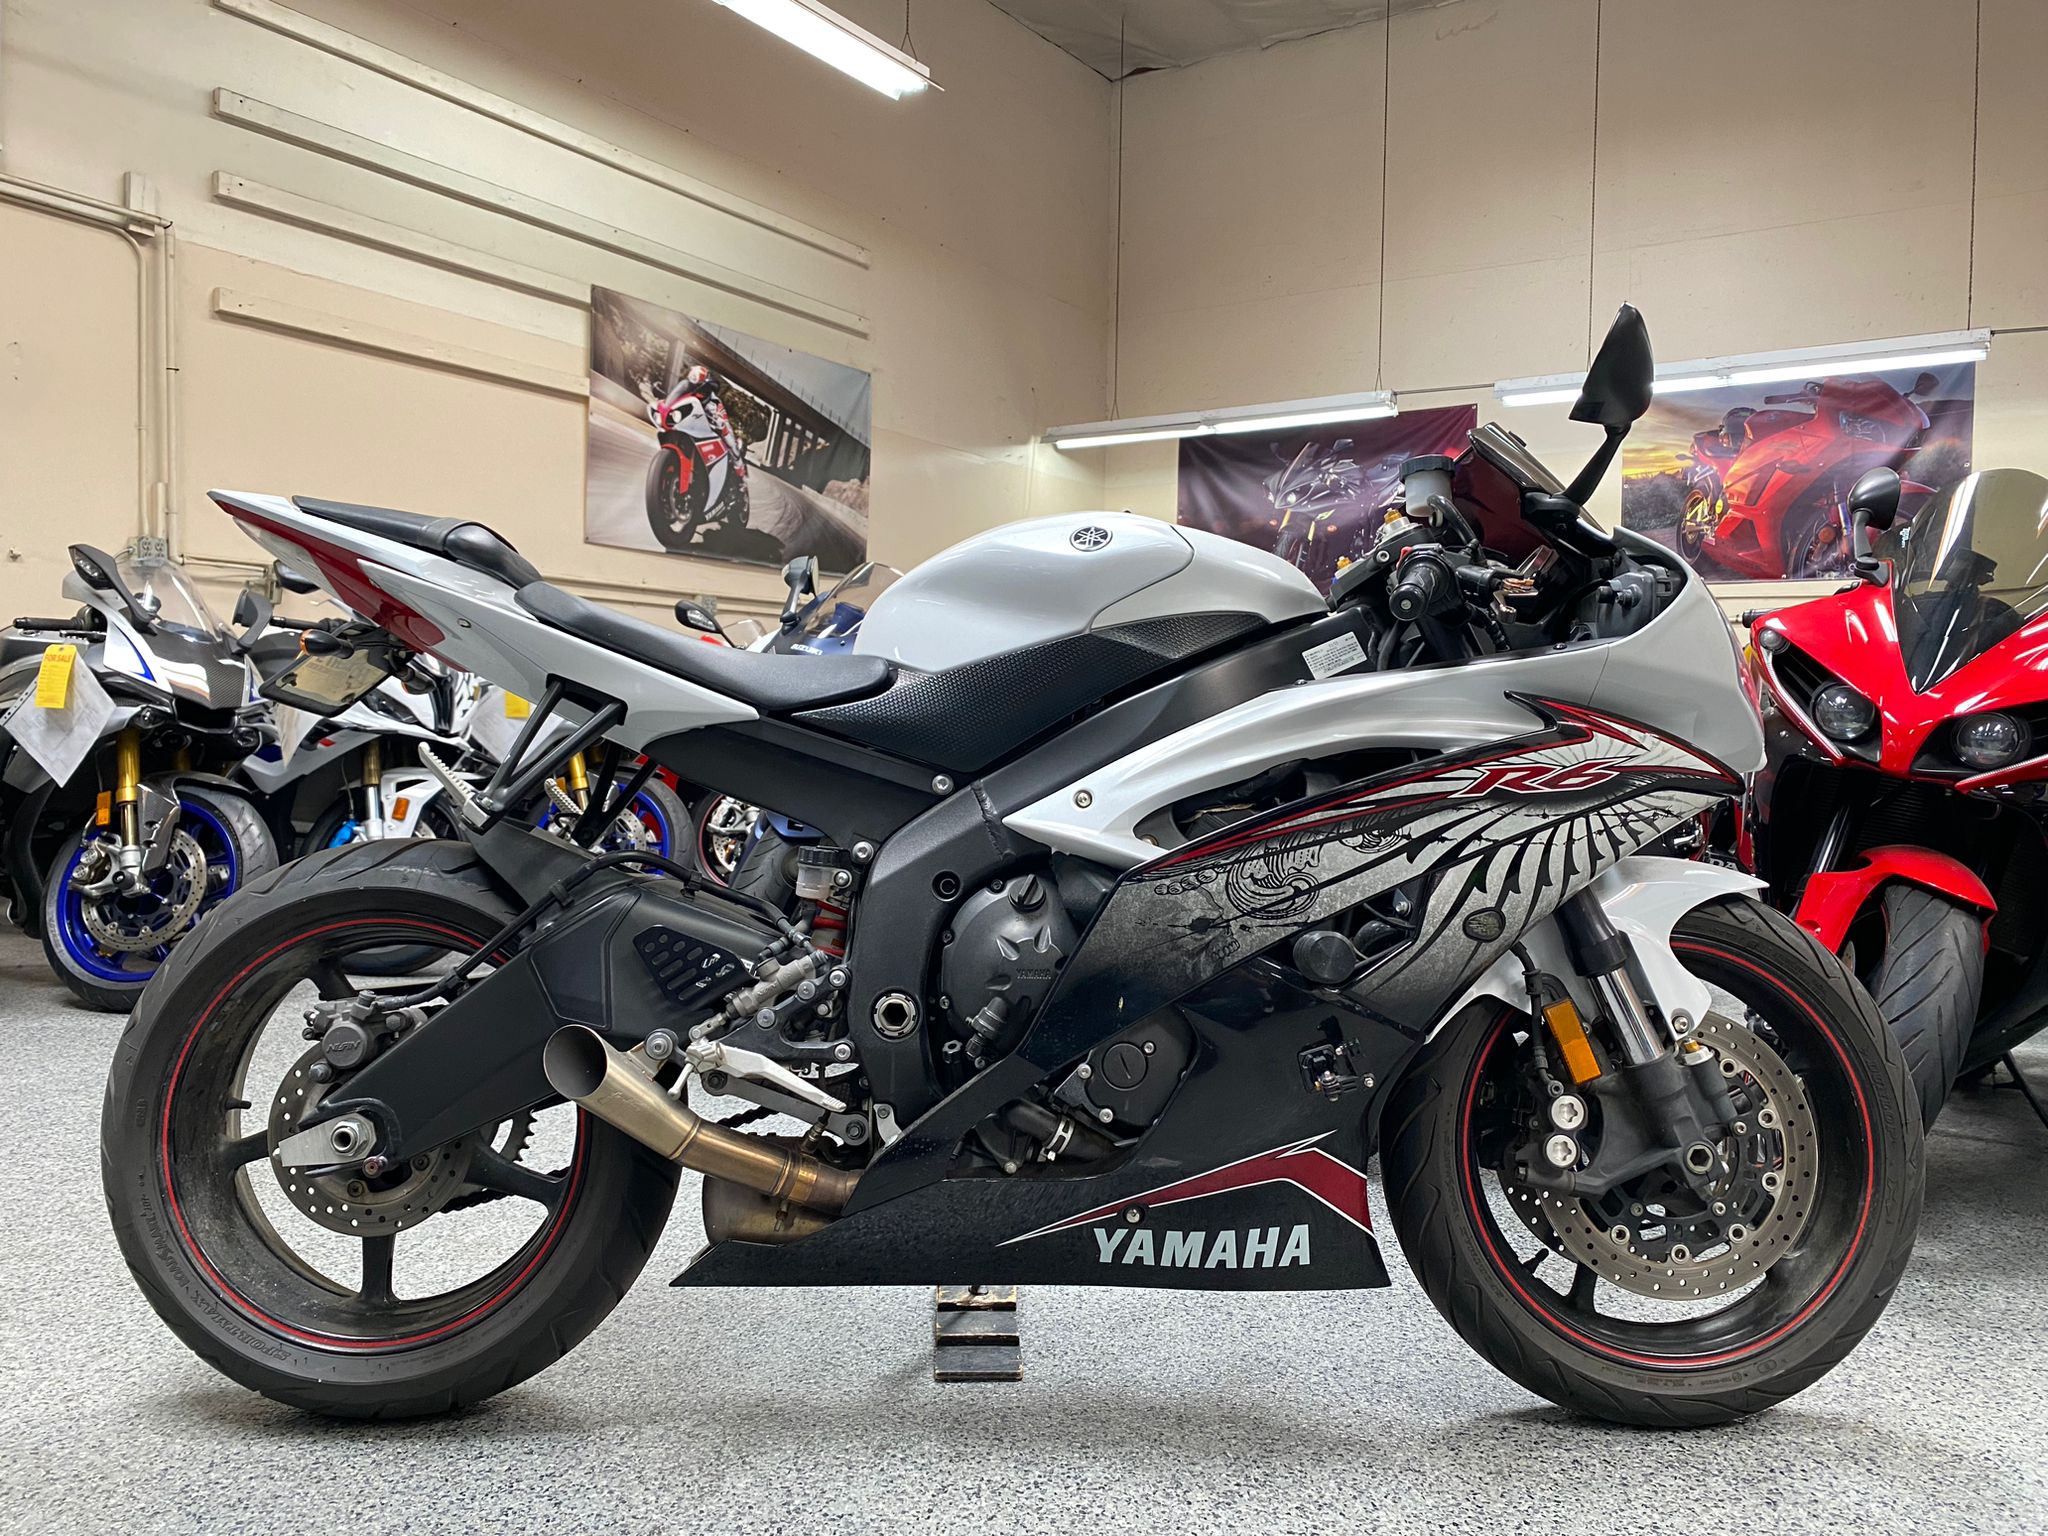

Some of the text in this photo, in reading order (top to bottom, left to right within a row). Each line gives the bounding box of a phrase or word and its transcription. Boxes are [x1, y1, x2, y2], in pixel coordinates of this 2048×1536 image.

[45, 654, 72, 663] FOR SALE
[1447, 755, 1634, 799] R6
[1015, 967, 1052, 980] YAMAHA
[1093, 1223, 1311, 1269] YAMAHA
